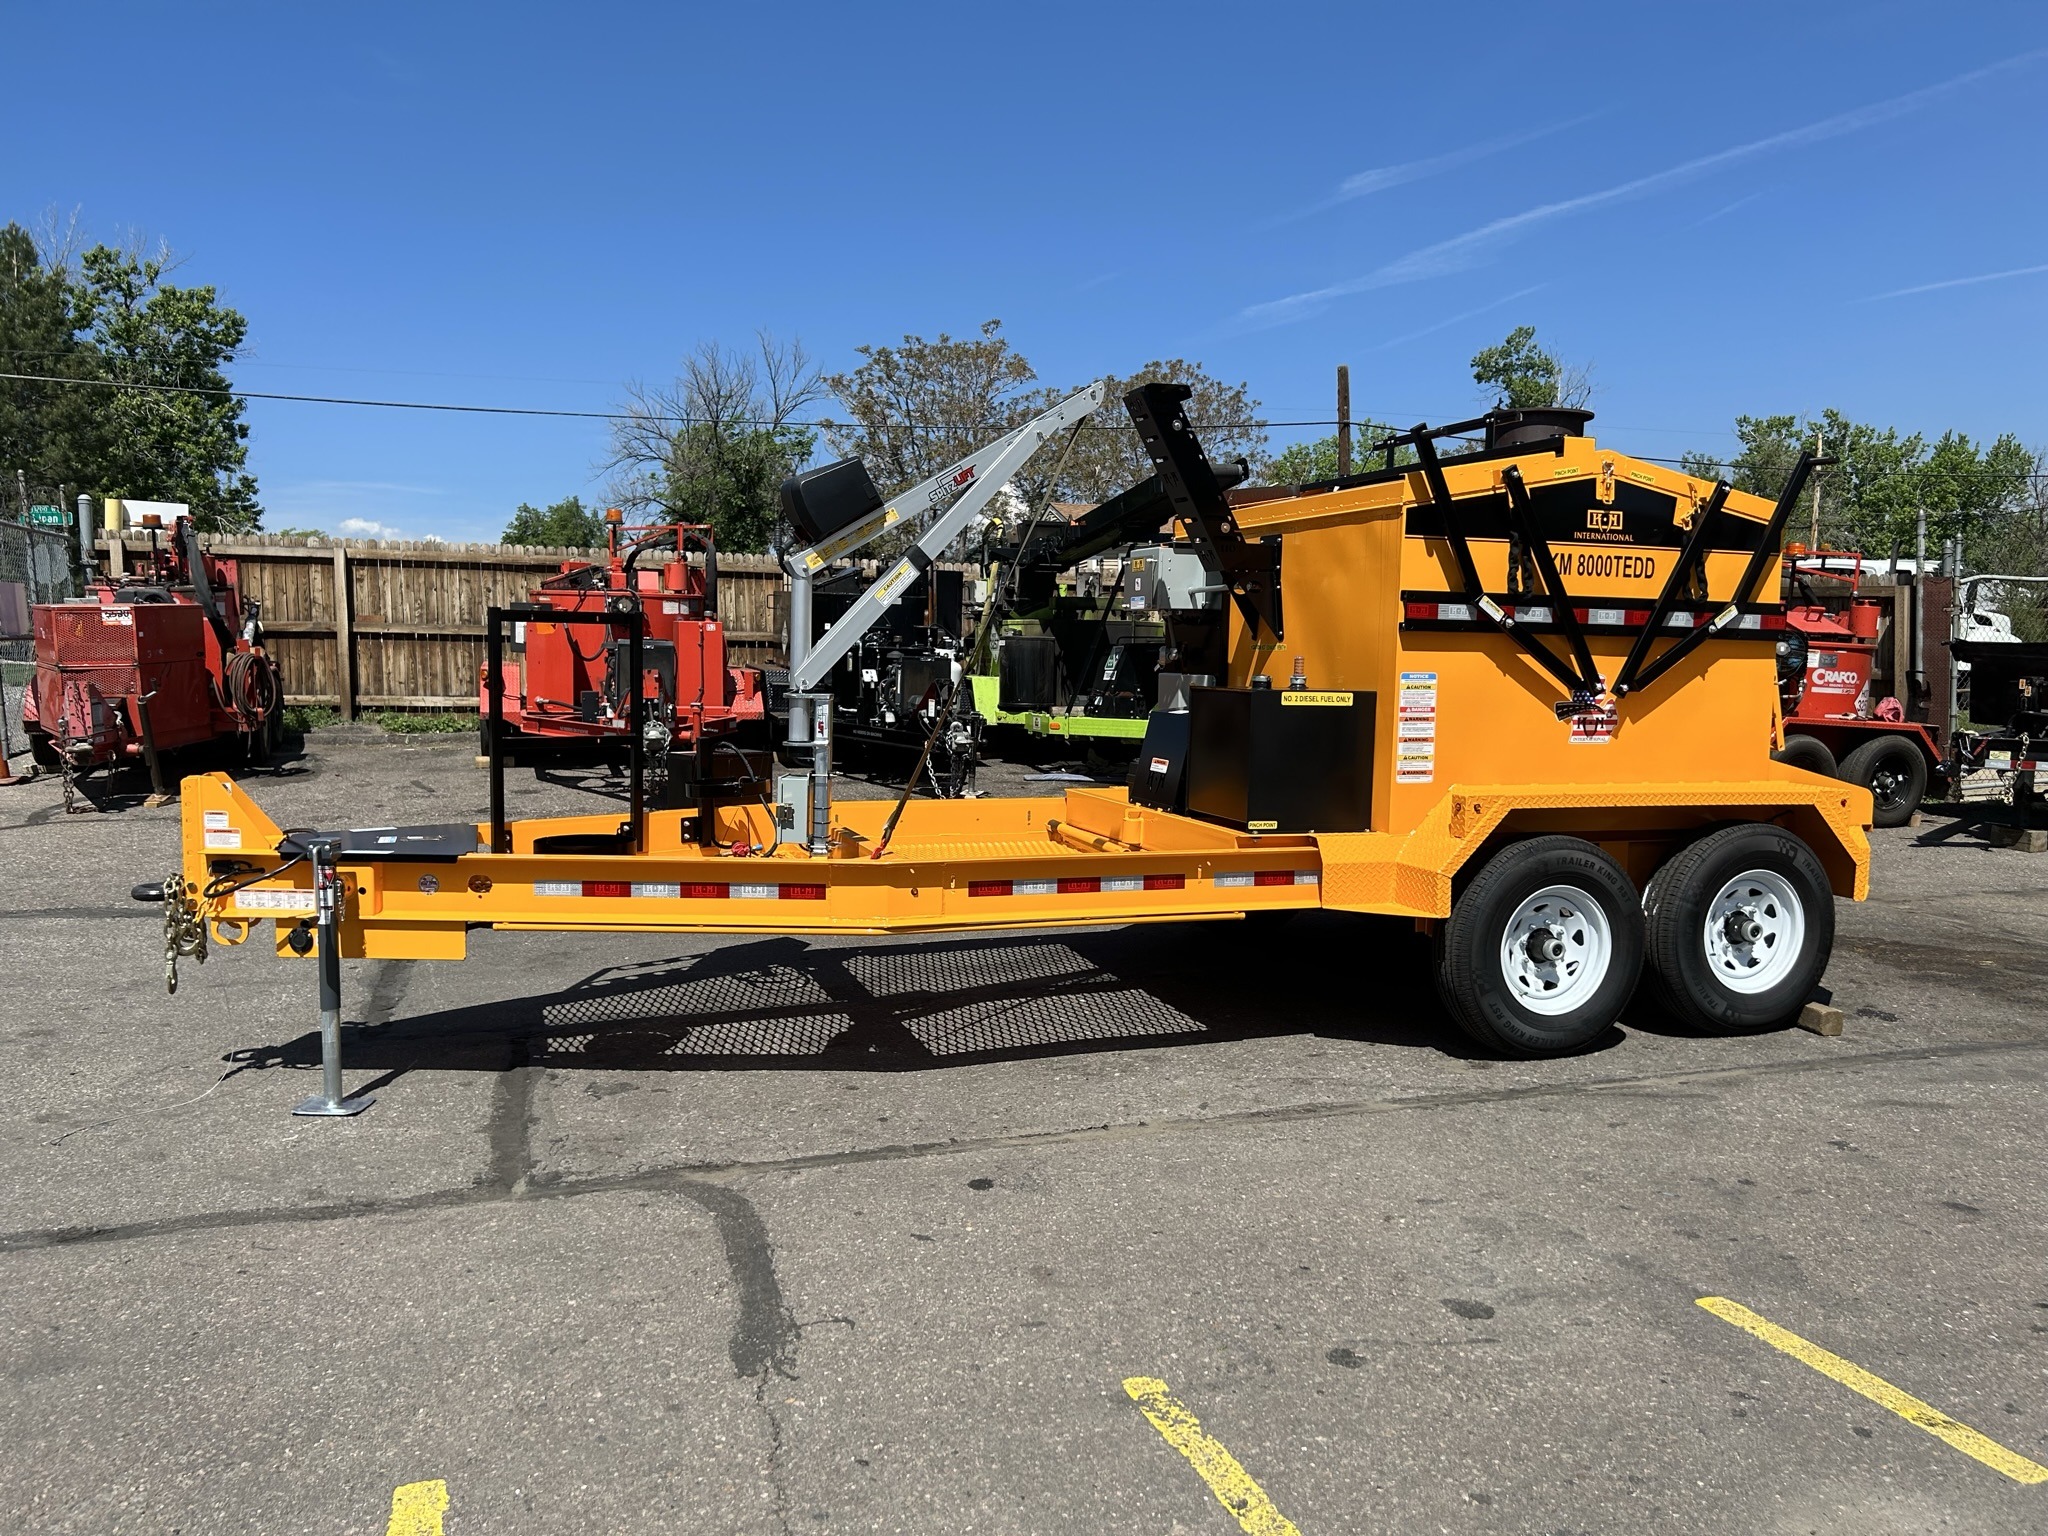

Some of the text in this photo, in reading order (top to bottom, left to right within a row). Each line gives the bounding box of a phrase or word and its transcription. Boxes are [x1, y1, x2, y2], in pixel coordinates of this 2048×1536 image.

[1573, 531, 1634, 542] INTERNATIONAL
[1577, 553, 1655, 579] 8000TEDD
[883, 572, 902, 591] CAUTION
[1811, 668, 1858, 685] CRAFCO
[1320, 695, 1334, 703] FUEL
[1335, 695, 1351, 703] ONLY
[1557, 856, 1632, 903] TRAILER KING RST
[1488, 1001, 1506, 1020] RST
[1503, 1020, 1526, 1040] KING
